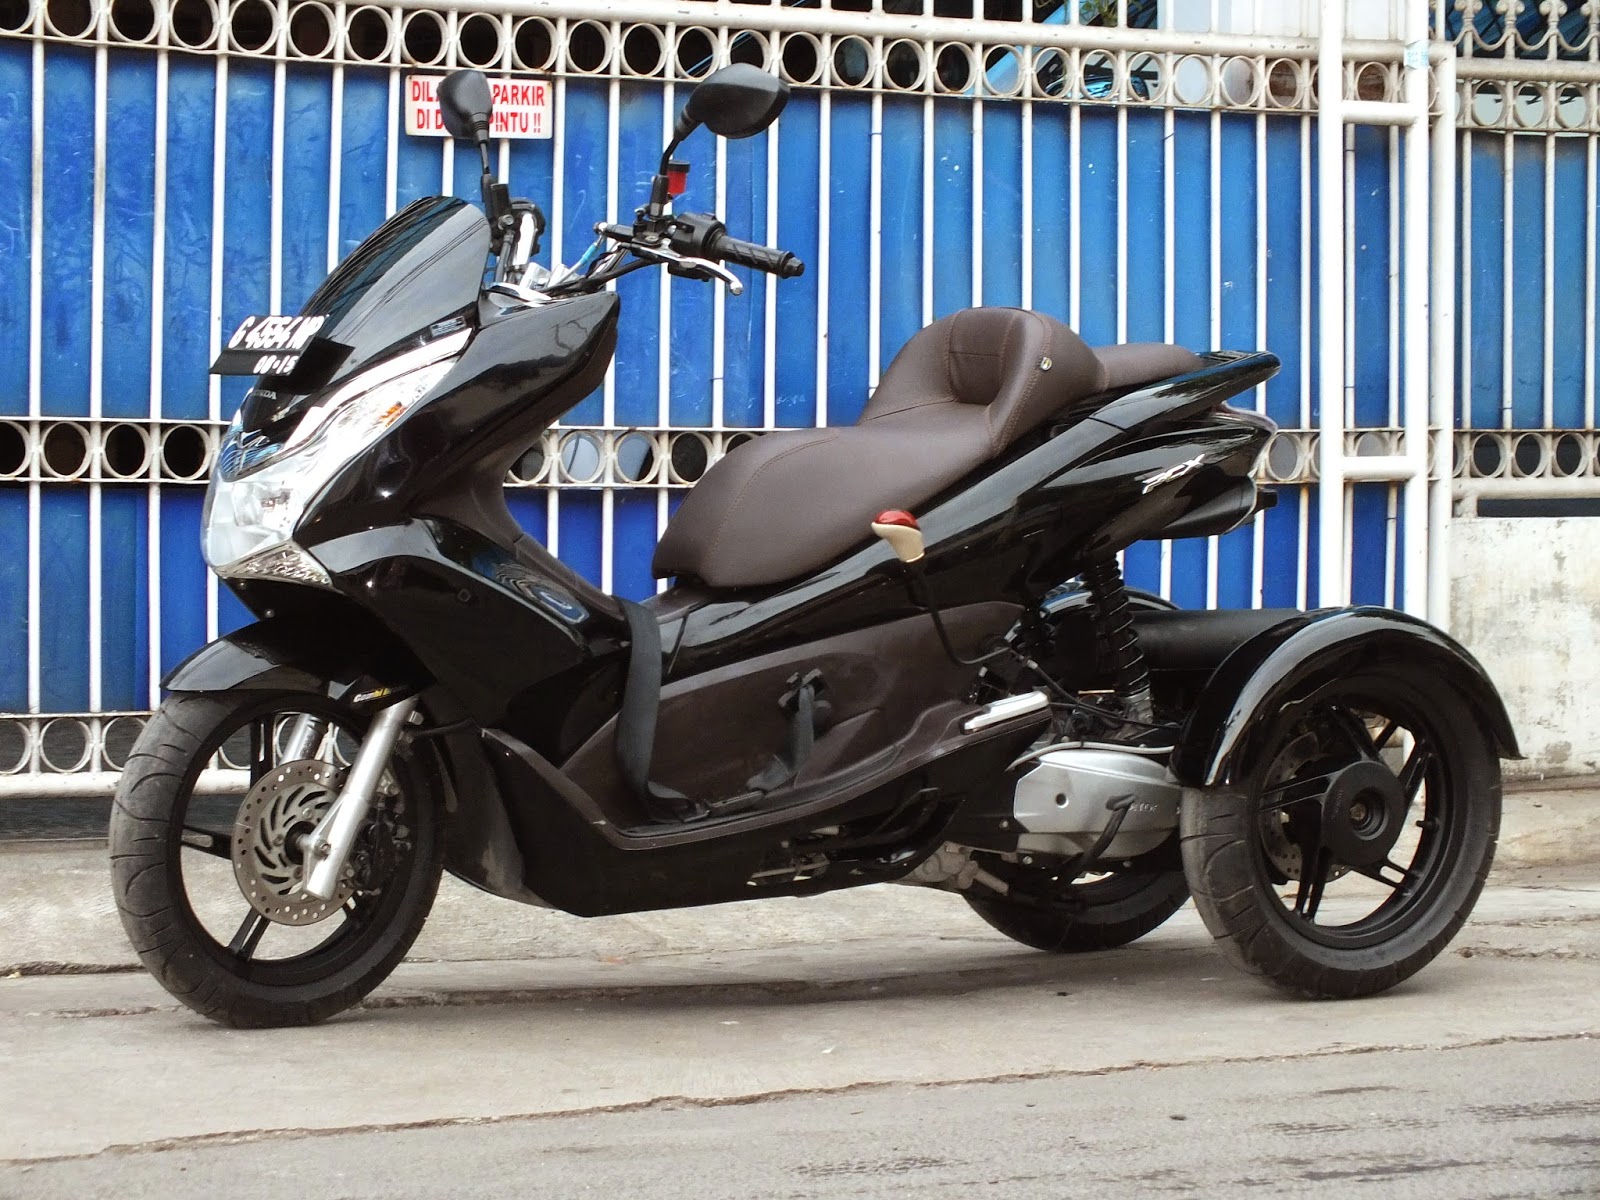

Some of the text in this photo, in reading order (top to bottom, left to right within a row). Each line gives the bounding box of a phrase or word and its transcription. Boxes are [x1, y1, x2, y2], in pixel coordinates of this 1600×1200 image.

[492, 84, 545, 106] PARKIR
[417, 108, 430, 129] DI
[1142, 453, 1205, 494] PCX
